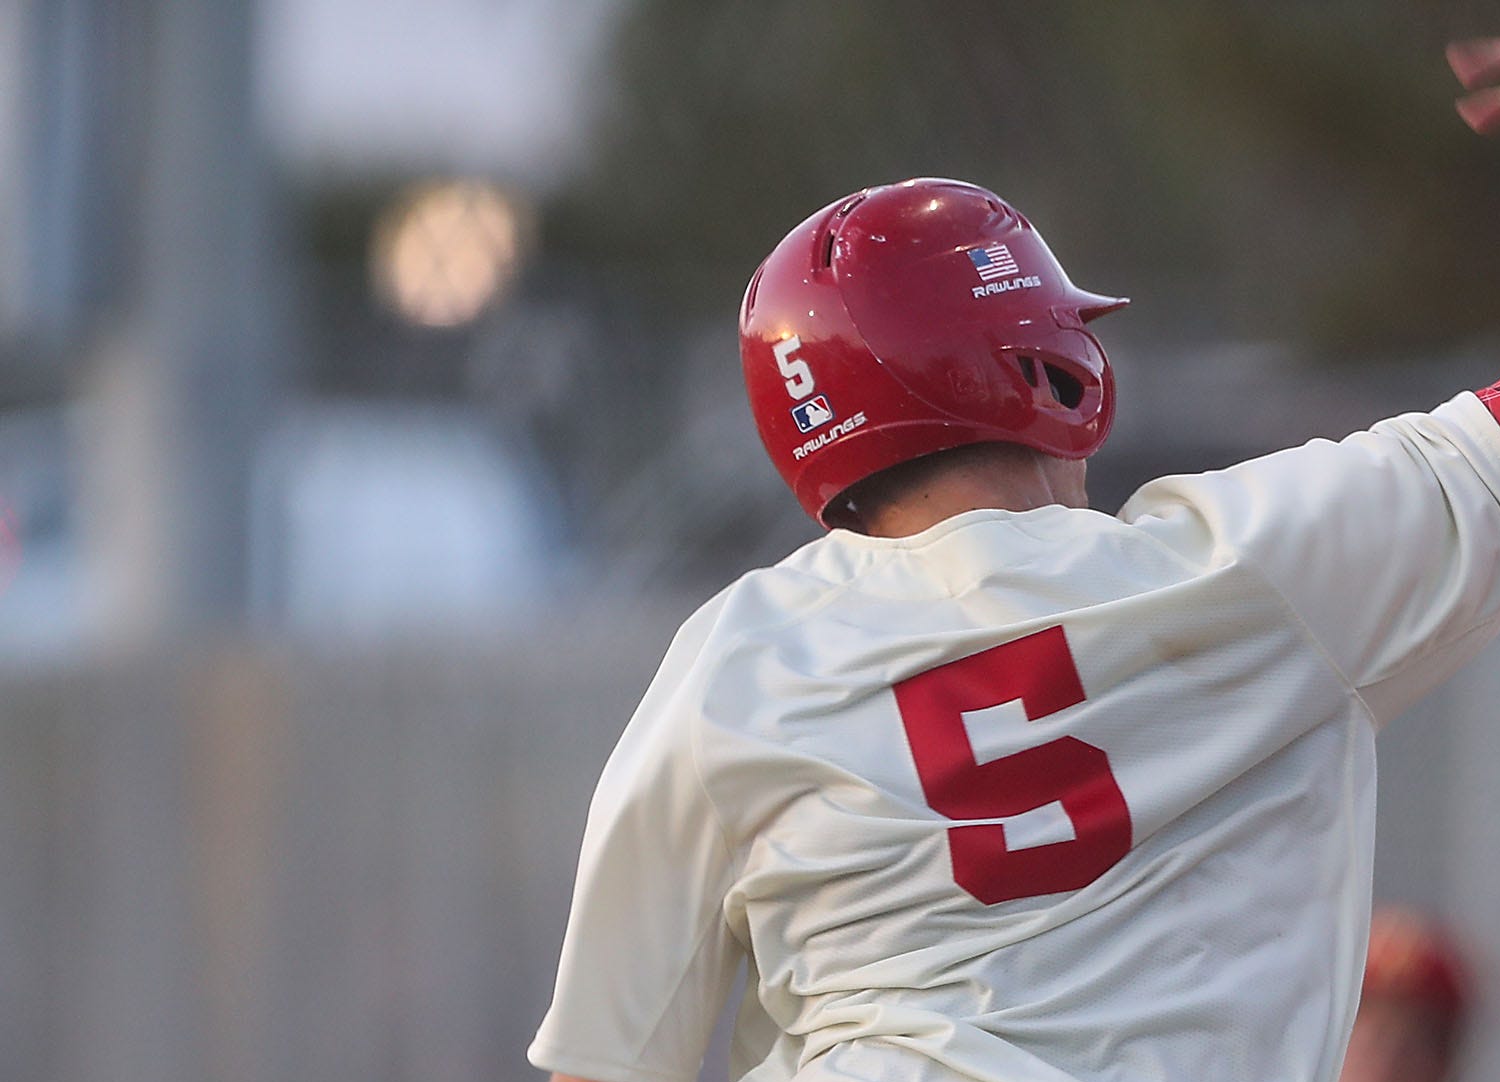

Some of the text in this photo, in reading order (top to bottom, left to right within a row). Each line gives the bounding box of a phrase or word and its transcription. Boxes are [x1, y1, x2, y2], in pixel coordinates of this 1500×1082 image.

[972, 275, 1042, 298] RAWLINGS
[773, 335, 815, 400] 5
[793, 411, 868, 460] RAWLINGS
[892, 624, 1133, 905] 5
